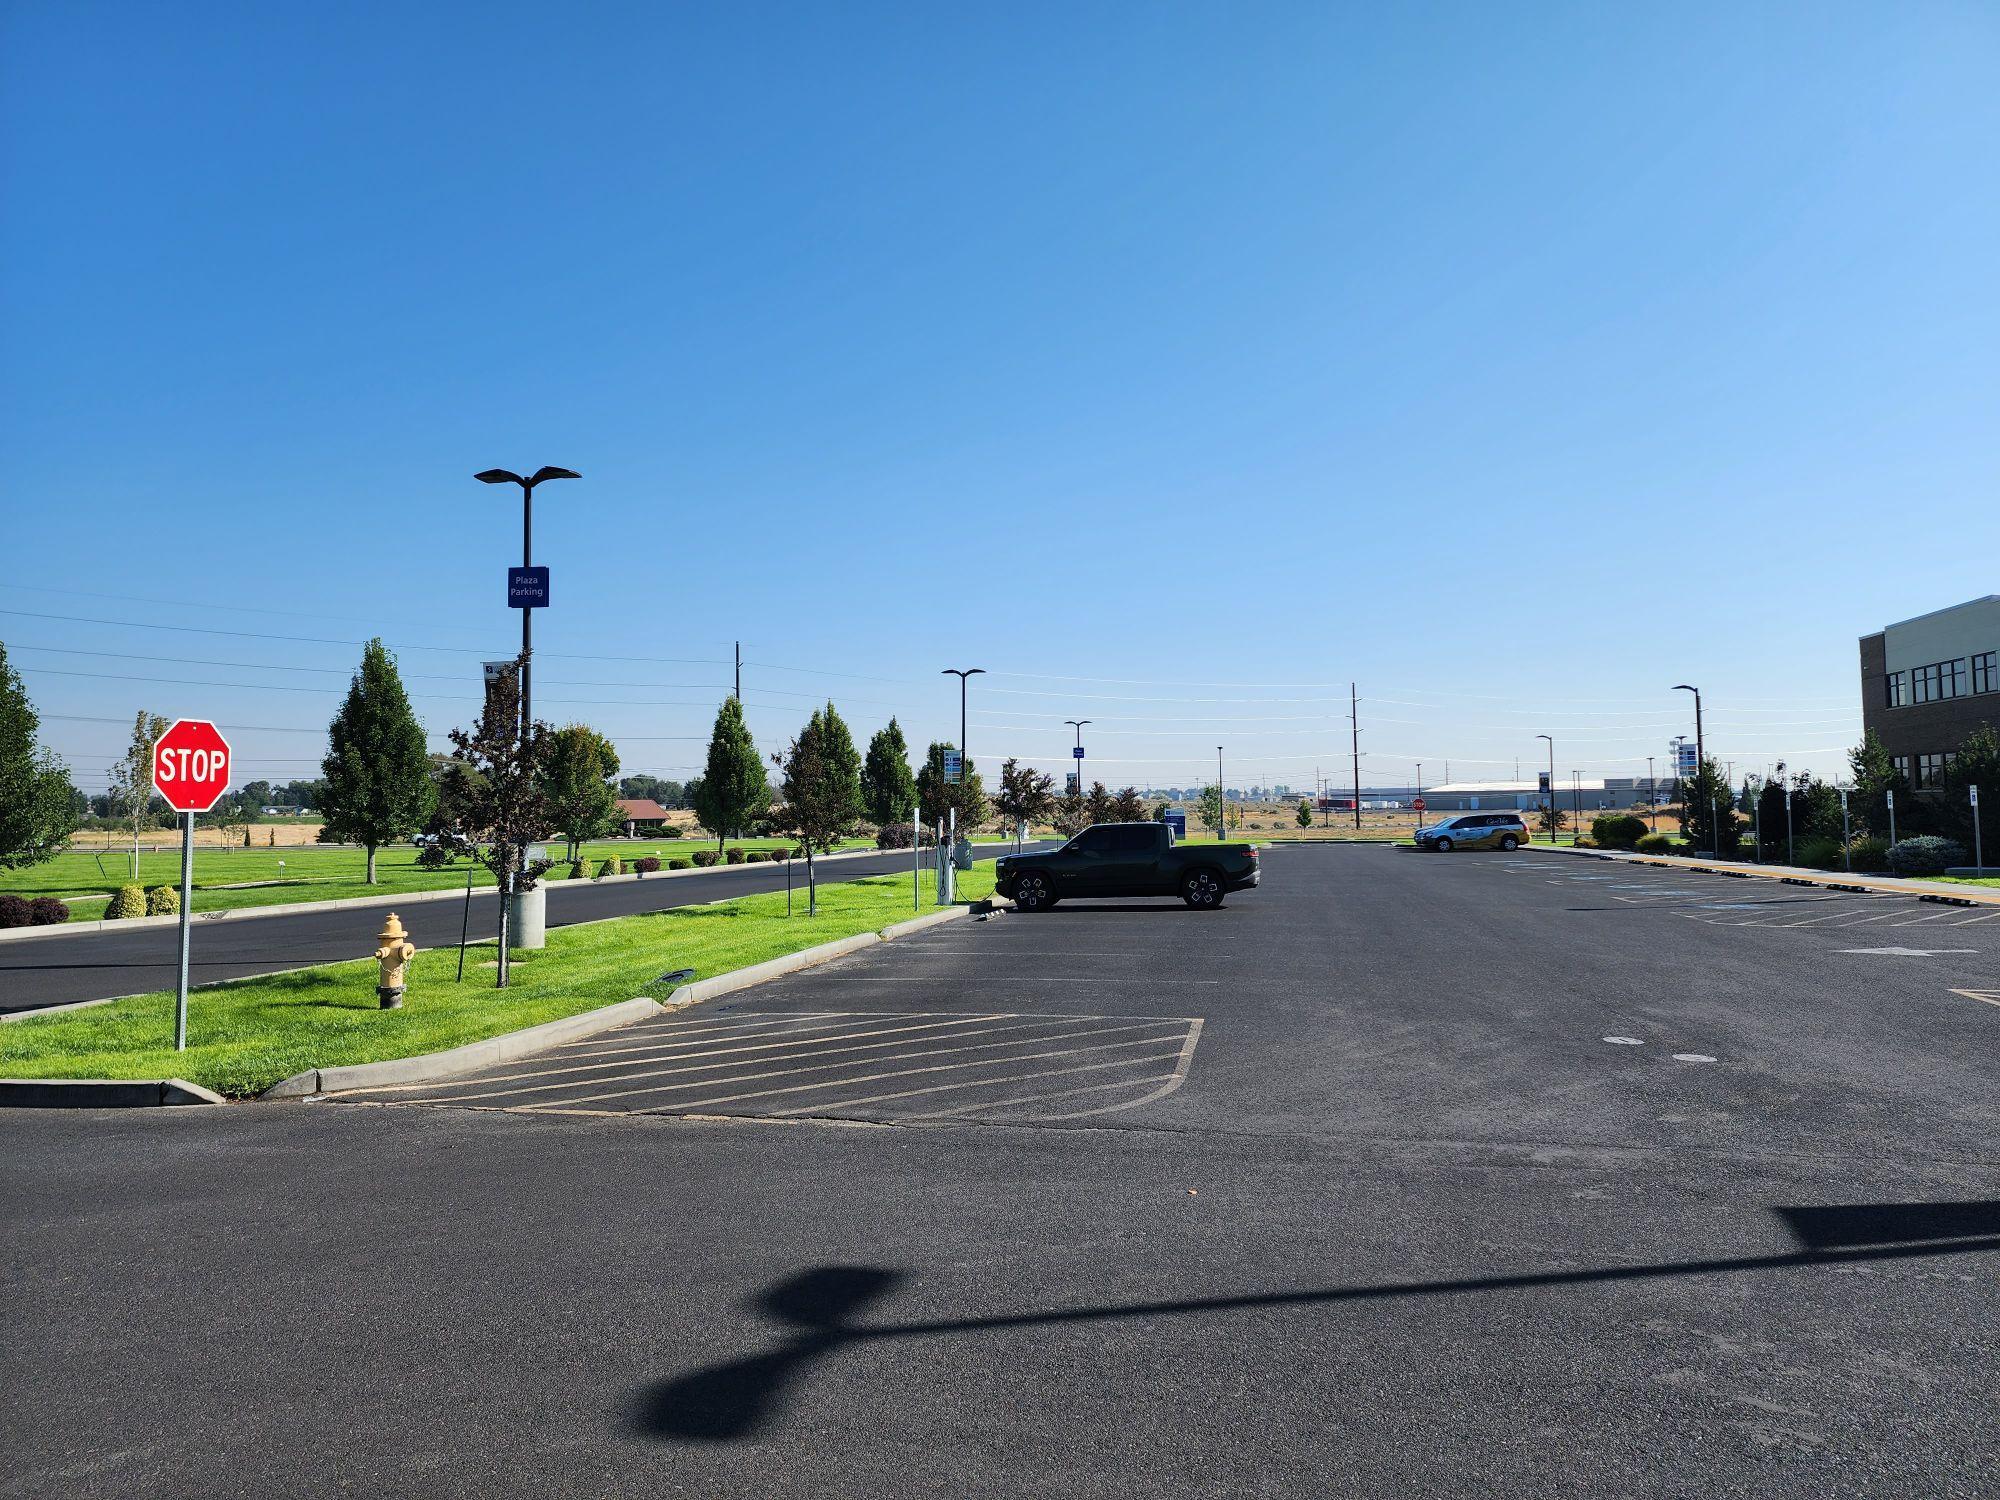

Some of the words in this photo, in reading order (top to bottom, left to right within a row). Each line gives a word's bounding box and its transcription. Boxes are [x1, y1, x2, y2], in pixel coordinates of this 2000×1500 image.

[515, 576, 538, 585] Plaza
[510, 587, 543, 597] Parking
[159, 747, 226, 783] STOP
